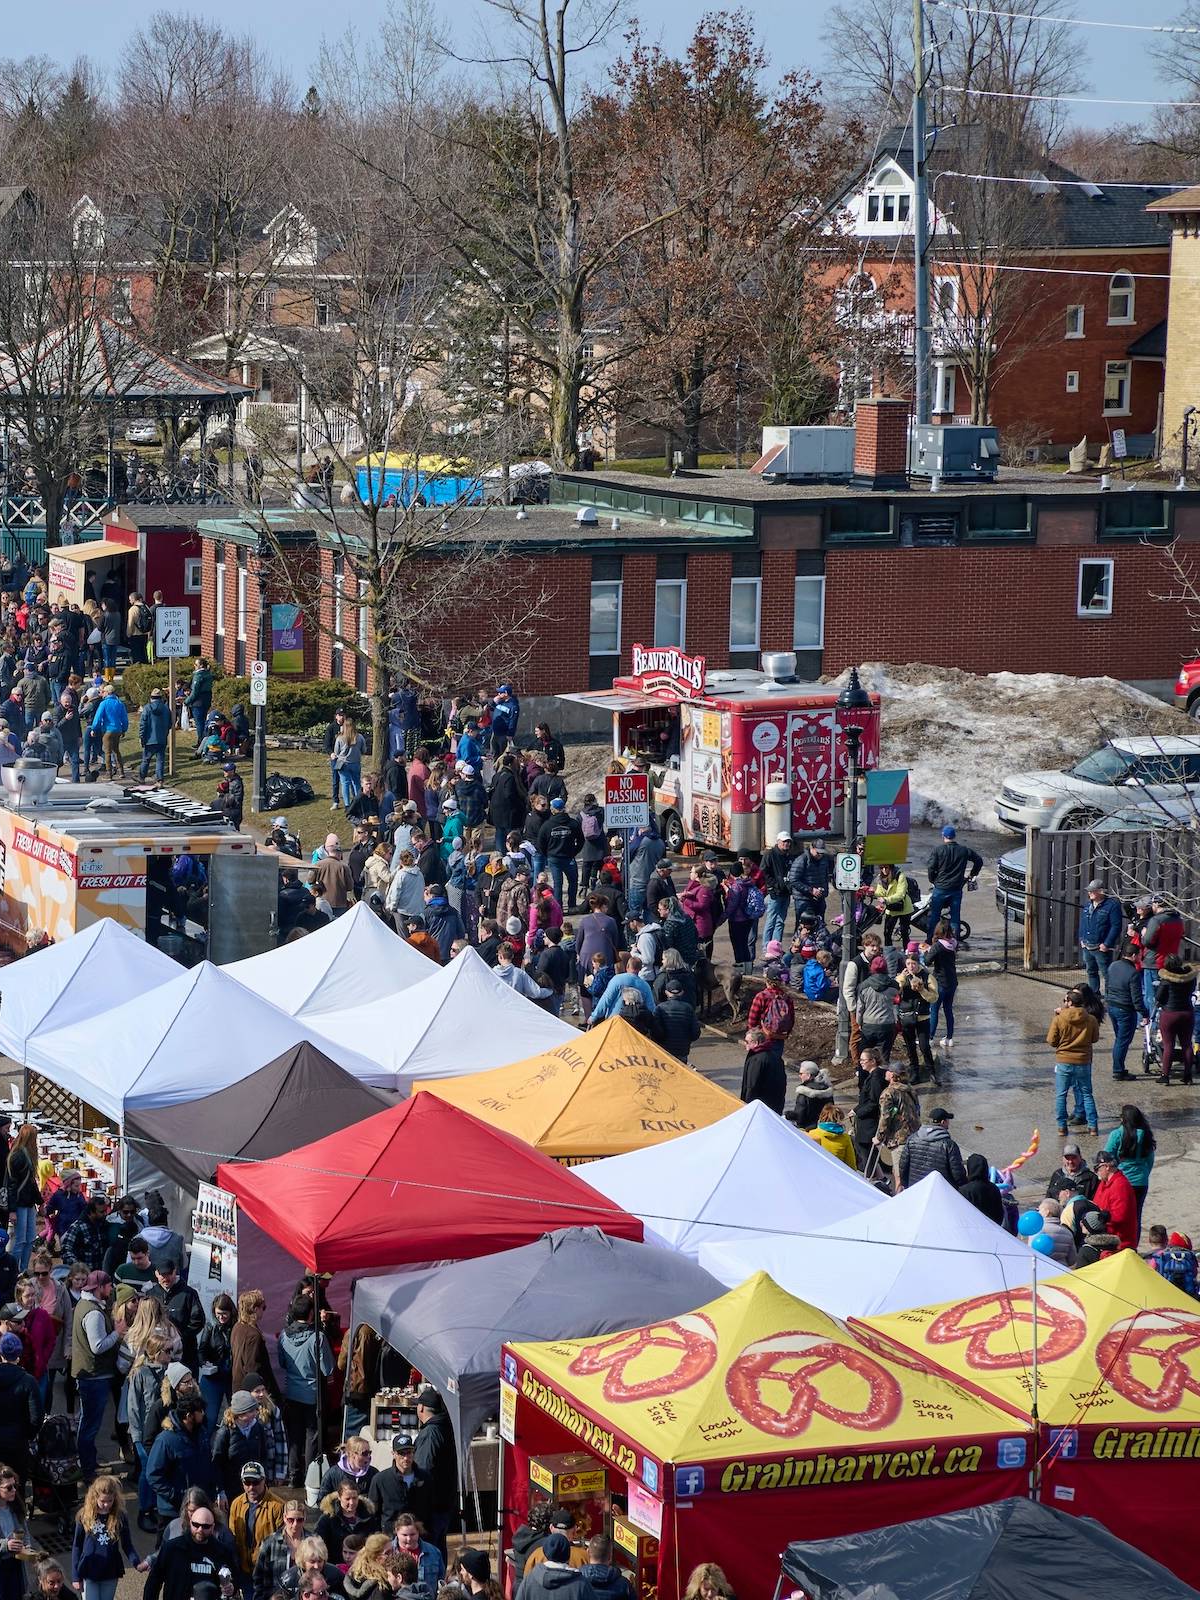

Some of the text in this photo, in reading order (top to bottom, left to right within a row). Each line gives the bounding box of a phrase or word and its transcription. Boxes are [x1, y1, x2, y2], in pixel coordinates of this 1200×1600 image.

[620, 777, 633, 790] NO
[608, 789, 645, 802] PASSING
[613, 806, 629, 814] HERE
[610, 815, 643, 824] CROSSING
[15, 832, 33, 853] FRESH
[32, 840, 44, 858] CUT
[43, 845, 59, 866] FRIES
[80, 876, 112, 888] FRESH
[113, 876, 132, 886] CUT
[598, 1054, 676, 1075] GARLIC
[640, 1118, 697, 1132] KING
[1070, 1380, 1108, 1400] Local
[912, 1400, 952, 1411] Since
[1076, 1398, 1114, 1409] Fresh
[659, 1400, 678, 1422] Since
[918, 1410, 954, 1420] 1989
[521, 1369, 637, 1476] Grainharvest.ca
[699, 1416, 738, 1433] Local
[703, 1428, 742, 1443] Fresh
[720, 1444, 984, 1494] Grainharvest.ca
[191, 1562, 212, 1574] PUMA
